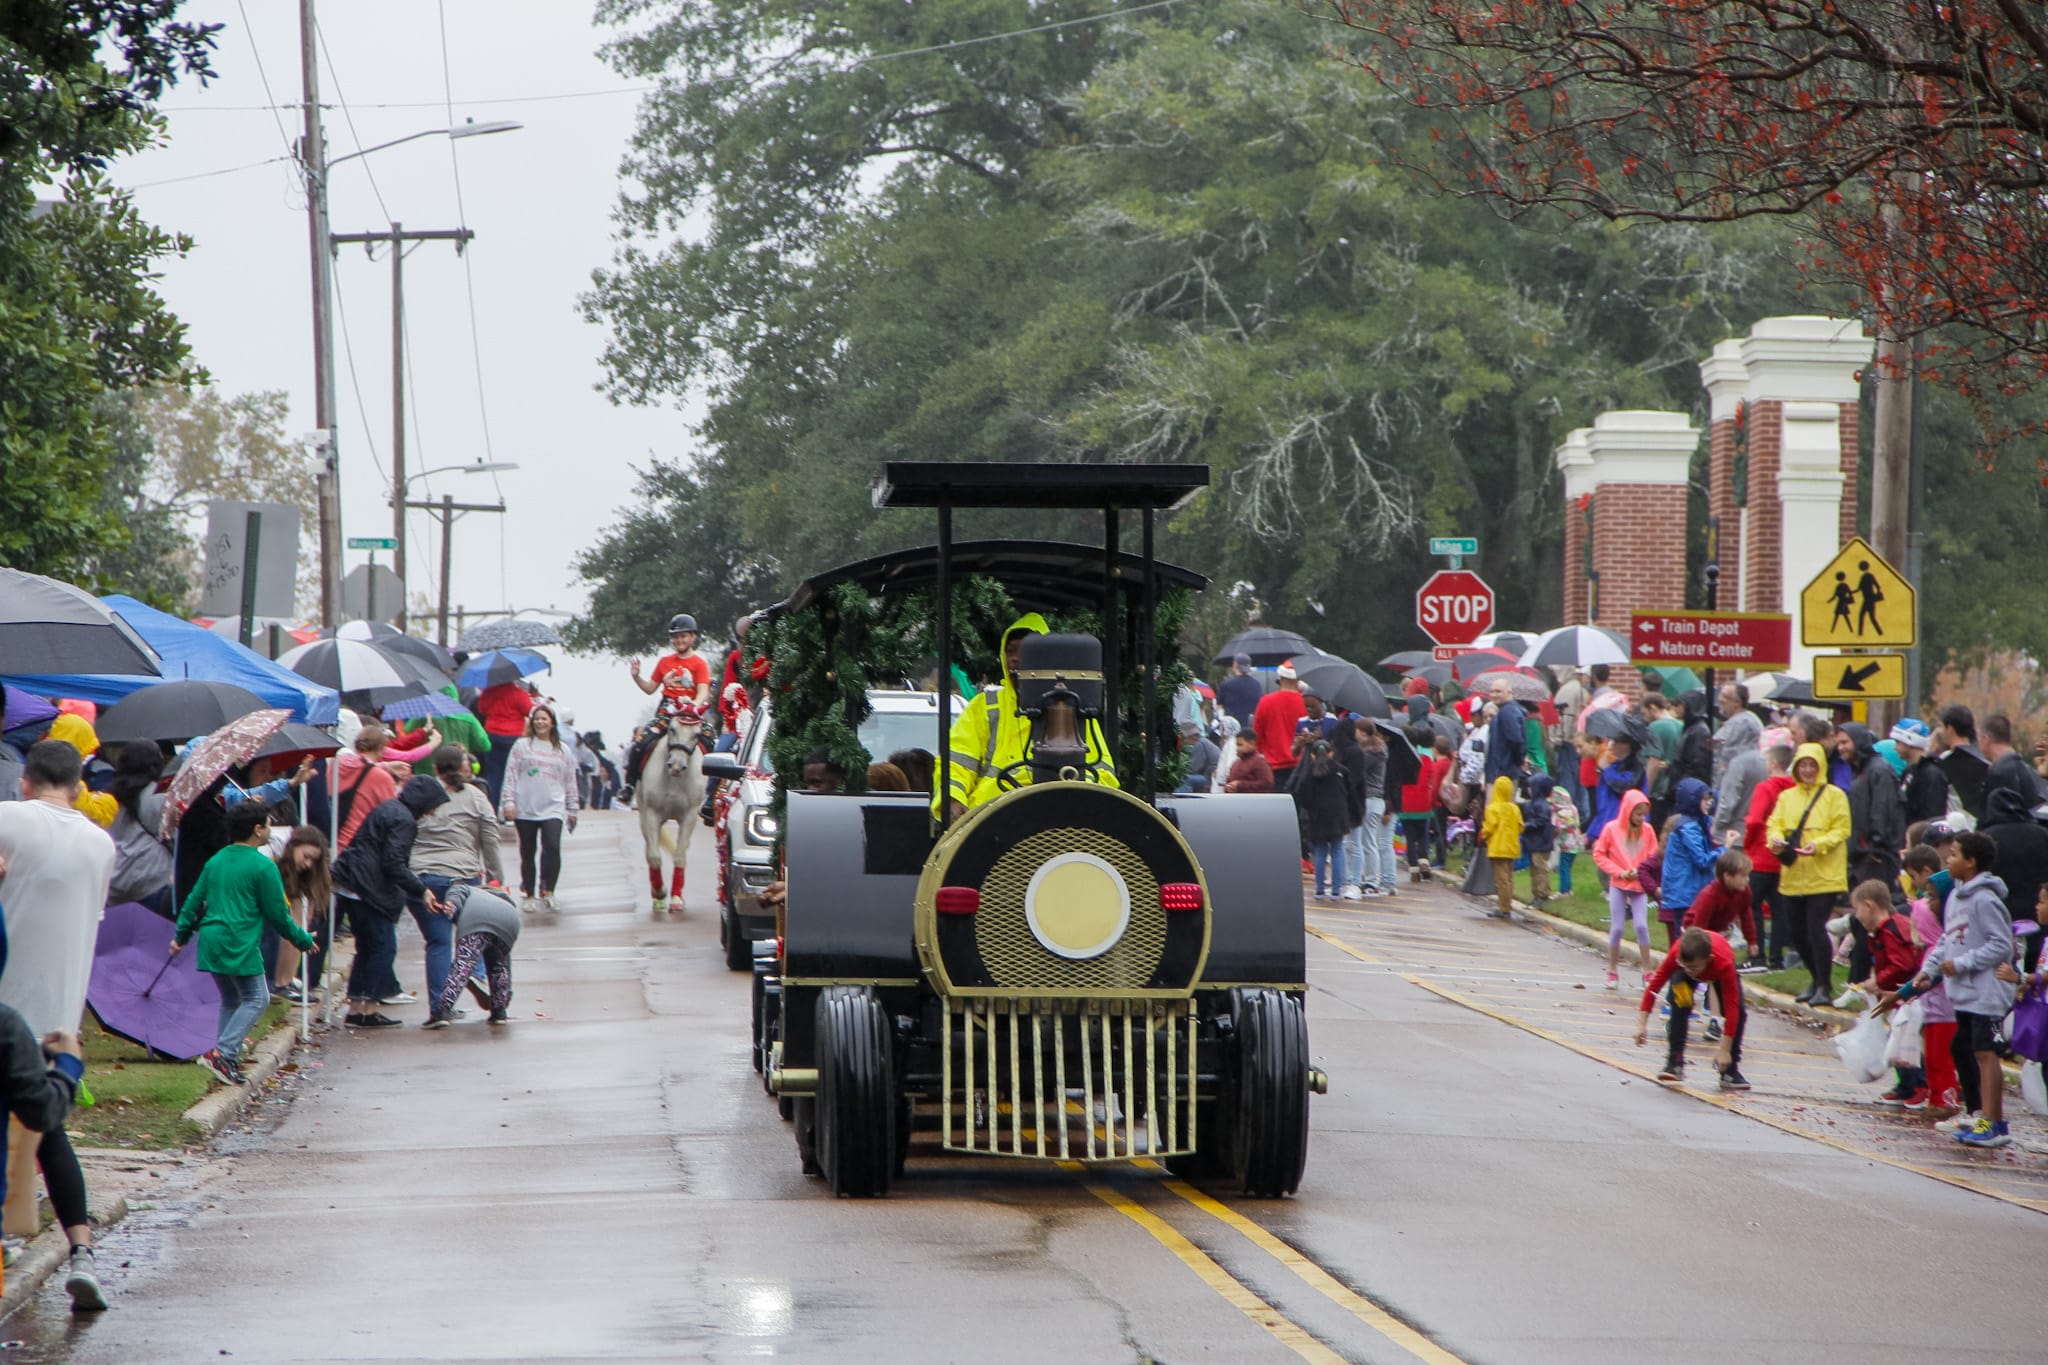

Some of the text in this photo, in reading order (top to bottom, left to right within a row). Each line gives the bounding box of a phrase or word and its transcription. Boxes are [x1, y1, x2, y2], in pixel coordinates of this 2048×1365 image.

[1422, 594, 1489, 624] STOP
[1661, 618, 1740, 637] Train Depot
[1436, 649, 1452, 659] ALL
[1659, 640, 1754, 658] Nature Center
